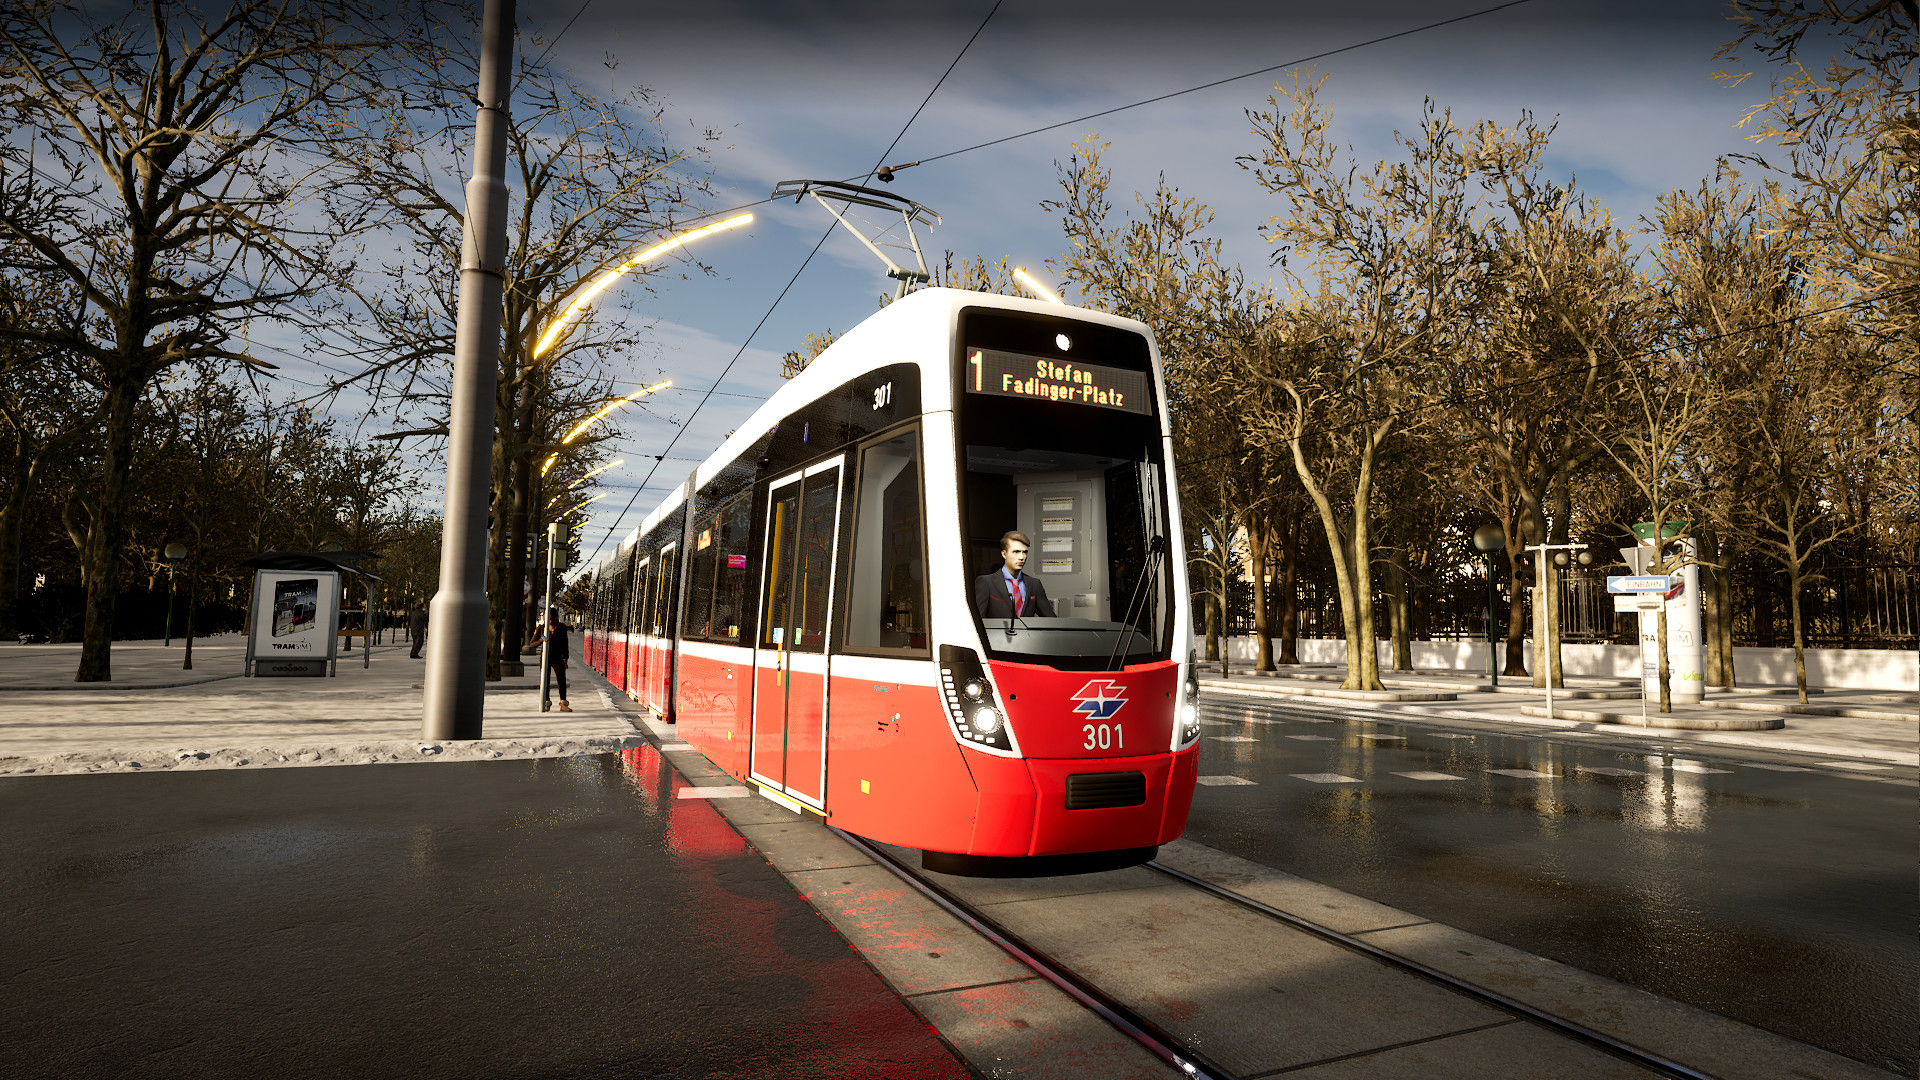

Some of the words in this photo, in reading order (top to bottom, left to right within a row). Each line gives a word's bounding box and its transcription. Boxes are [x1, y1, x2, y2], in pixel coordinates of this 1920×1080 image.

[970, 351, 983, 391] 1
[1036, 360, 1092, 384] Stefan
[872, 382, 892, 410] 301
[1002, 373, 1124, 407] Fadinger-Platz
[1626, 580, 1662, 588] EINBAHN
[1082, 723, 1123, 750] 301
